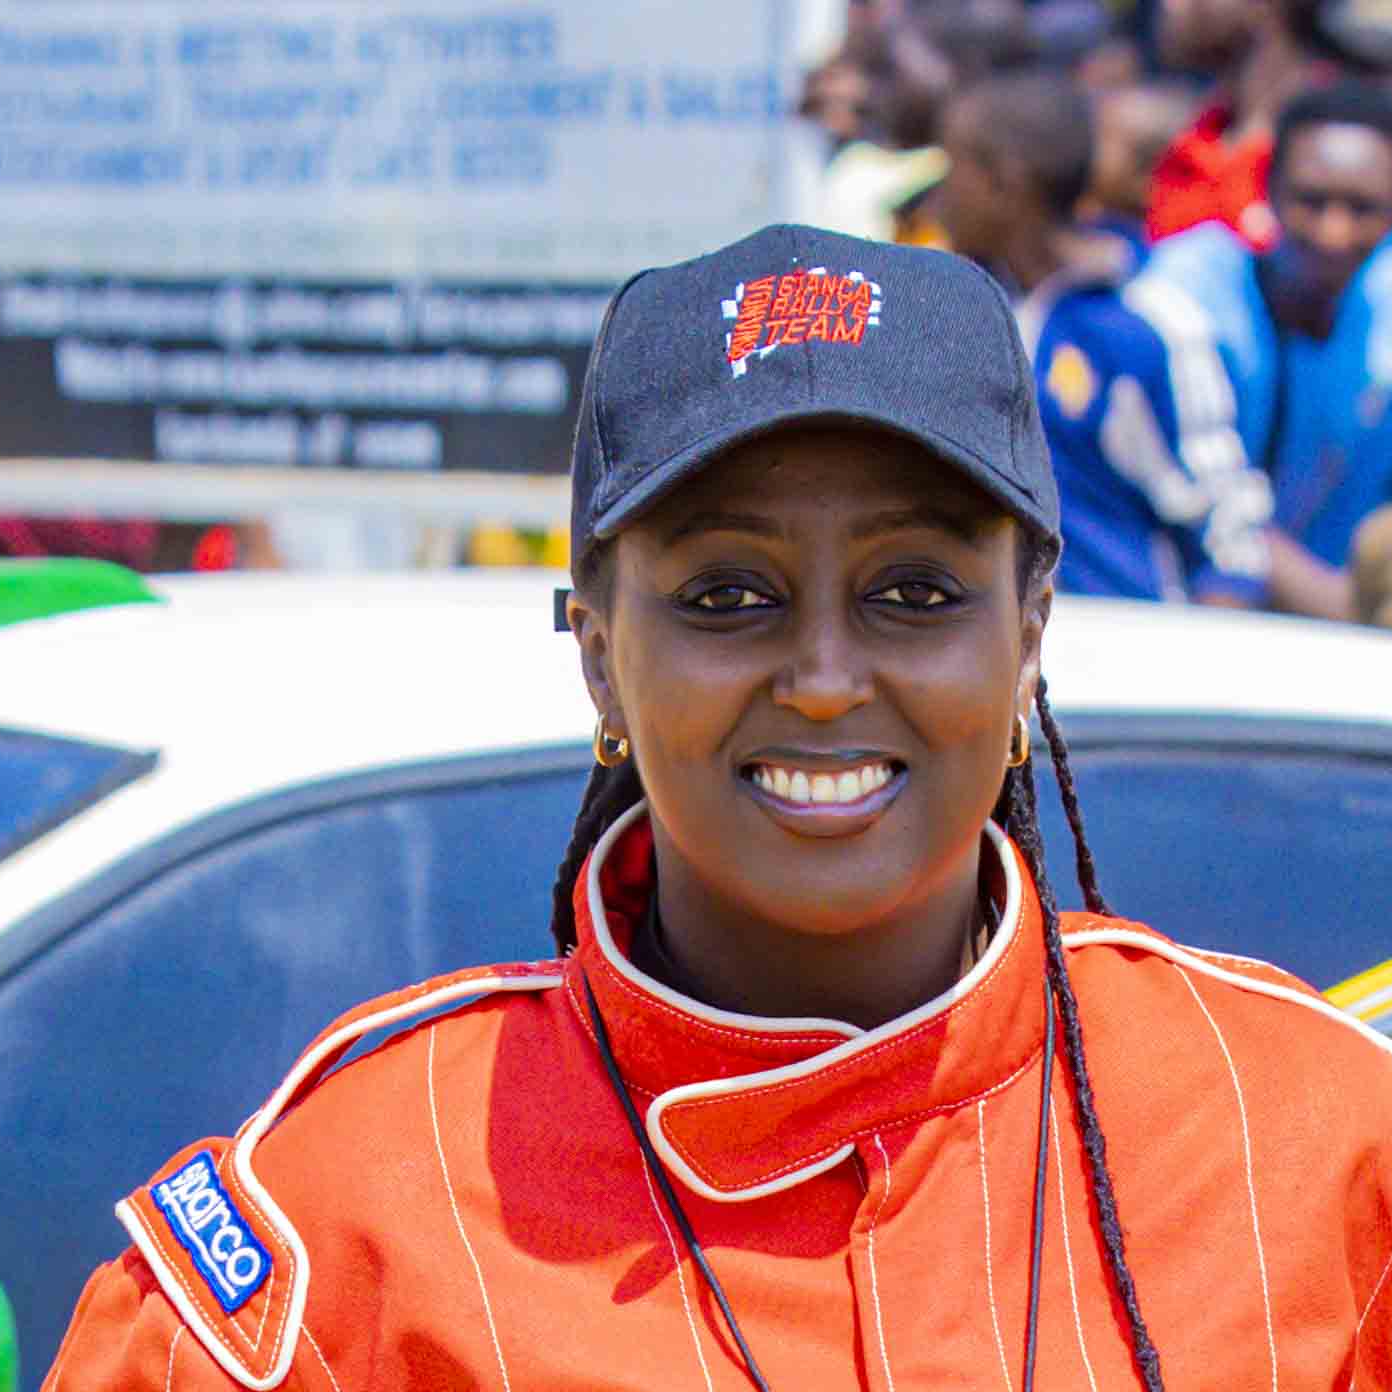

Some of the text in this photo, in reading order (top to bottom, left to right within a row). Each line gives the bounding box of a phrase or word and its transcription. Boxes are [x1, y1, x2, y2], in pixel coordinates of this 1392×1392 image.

[770, 295, 870, 320] RALLYE
[765, 315, 866, 347] TEAM
[159, 1161, 261, 1290] sparco
